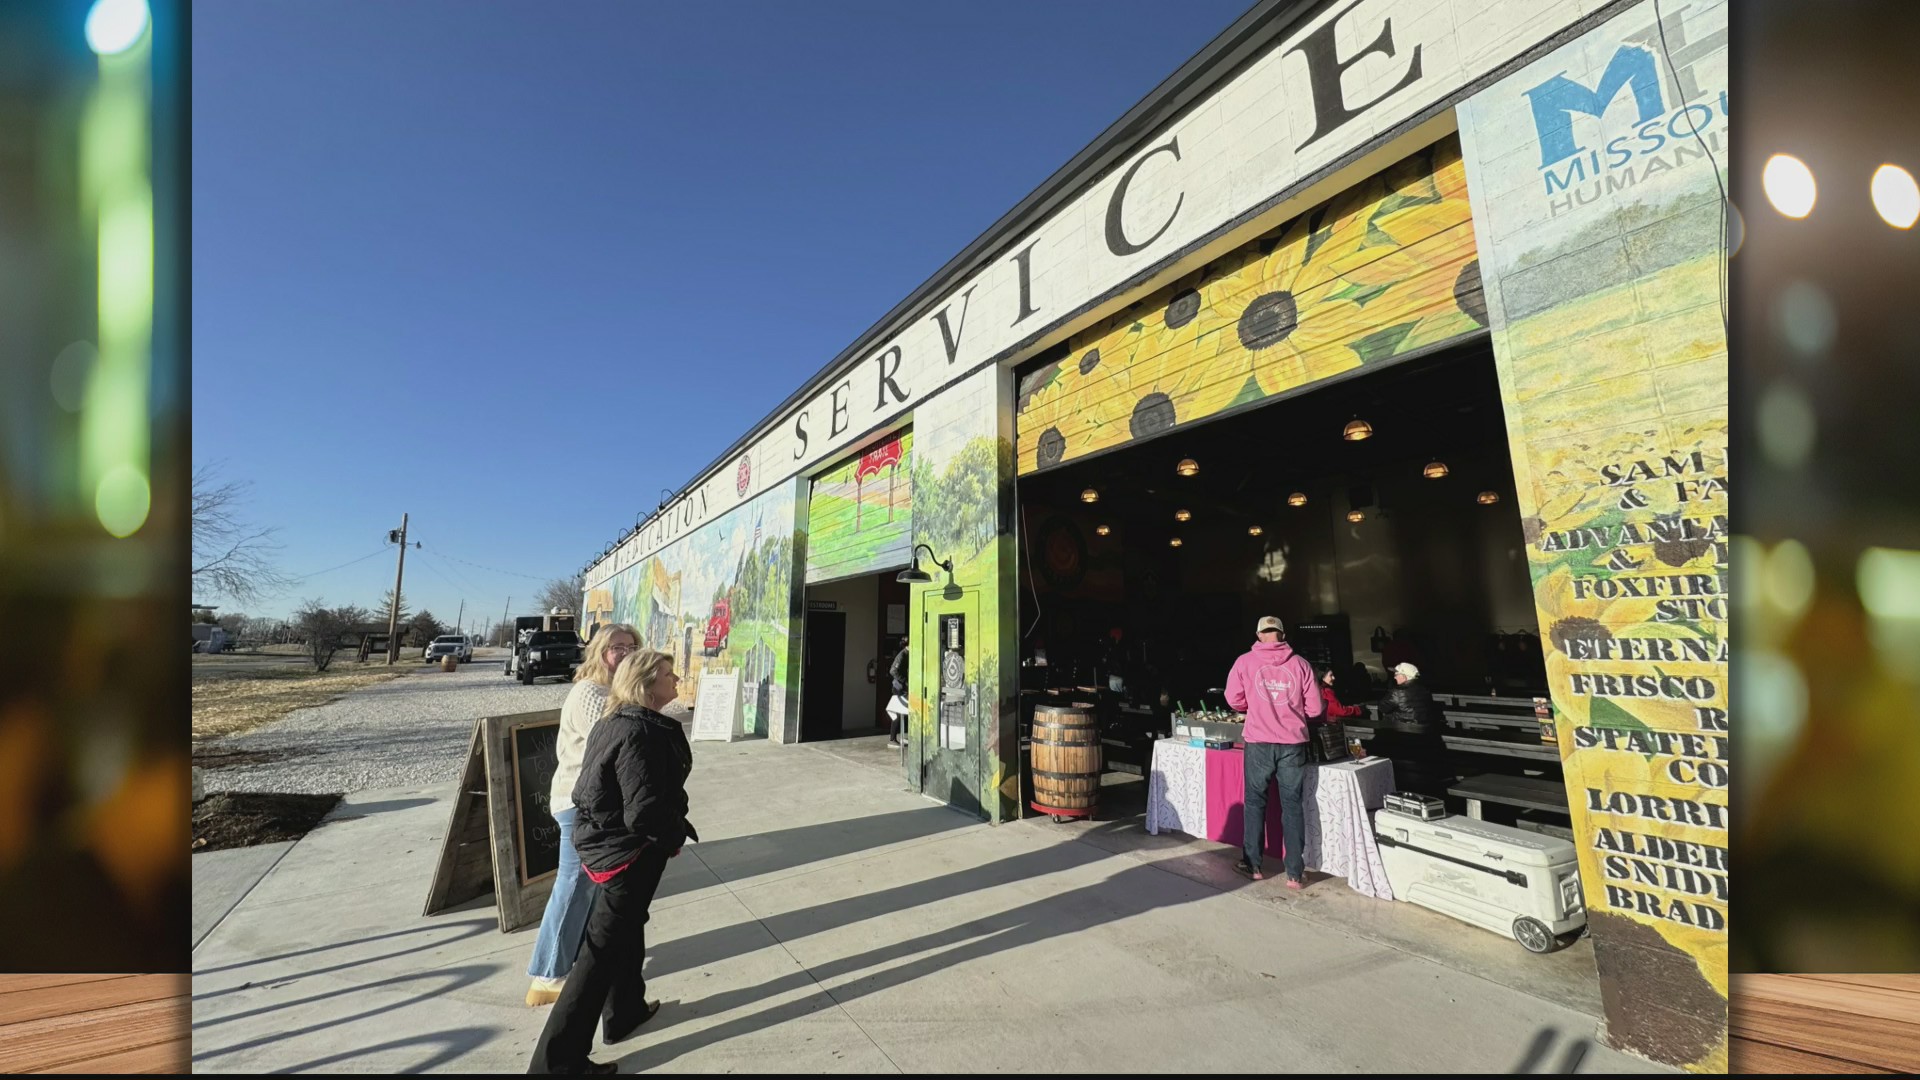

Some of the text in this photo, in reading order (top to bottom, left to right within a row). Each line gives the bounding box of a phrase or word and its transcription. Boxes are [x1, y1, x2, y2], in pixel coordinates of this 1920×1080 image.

[1550, 126, 1728, 217] HUMANI
[793, 0, 1422, 461] SERVICE
[1600, 450, 1705, 487] SAM
[1618, 488, 1648, 511] &
[1607, 549, 1644, 571] &
[1570, 673, 1715, 699] FRISCO
[1667, 760, 1728, 788] CO
[1606, 885, 1724, 930] BRAD
